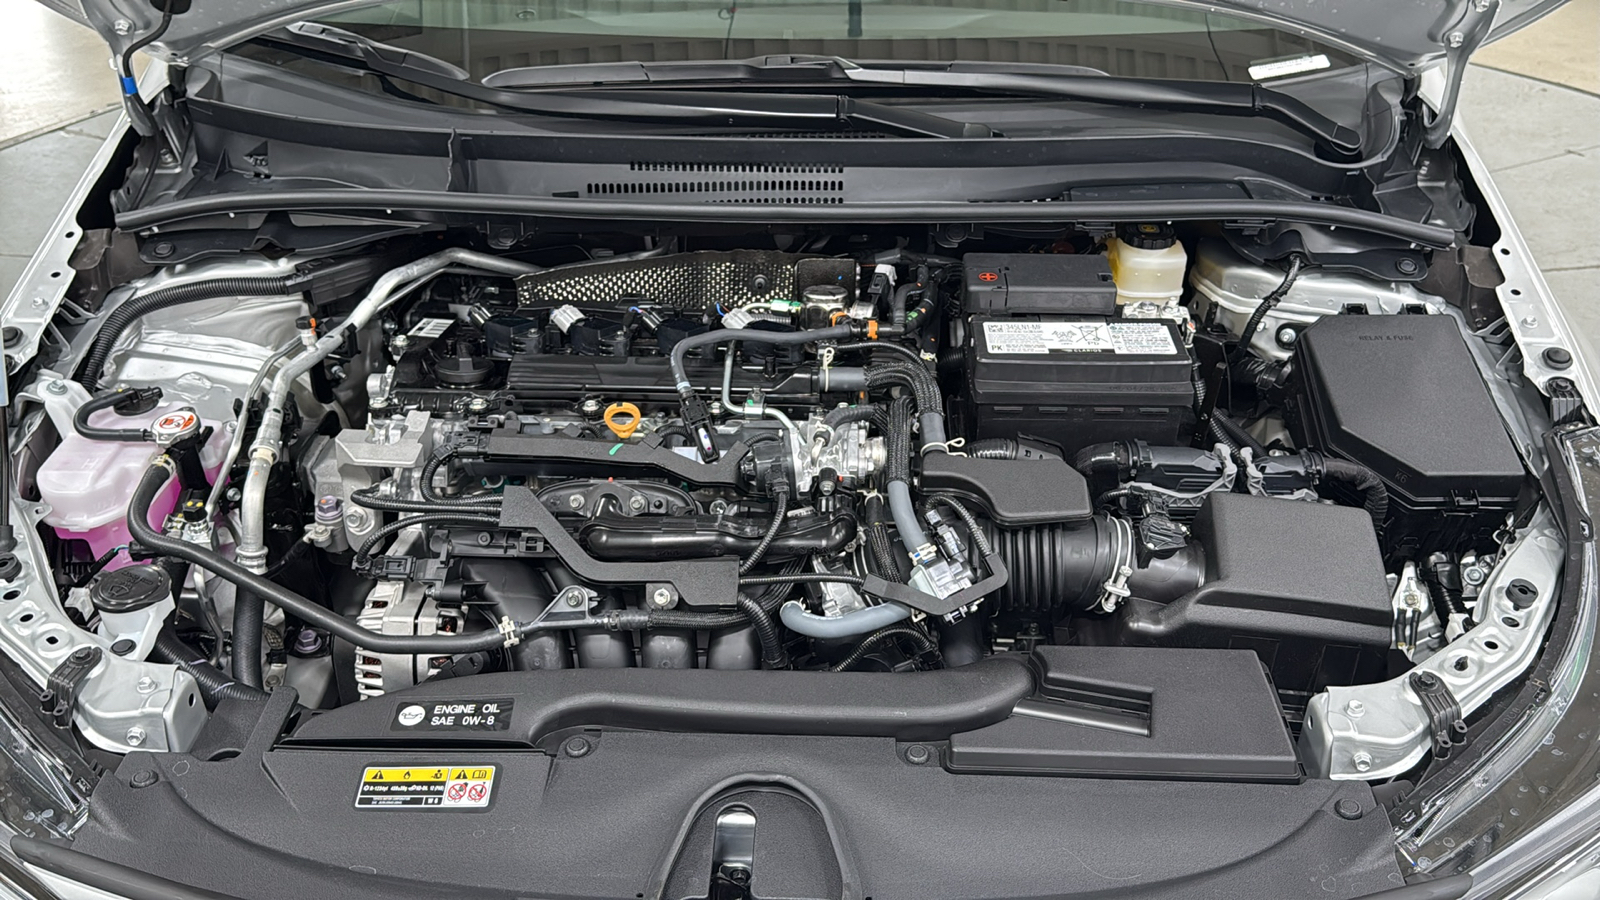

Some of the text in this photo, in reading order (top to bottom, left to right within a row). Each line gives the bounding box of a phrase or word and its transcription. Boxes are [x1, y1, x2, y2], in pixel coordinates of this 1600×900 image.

[433, 703, 500, 714] ENGINE OIL
[430, 715, 495, 726] SAE 0W-8
